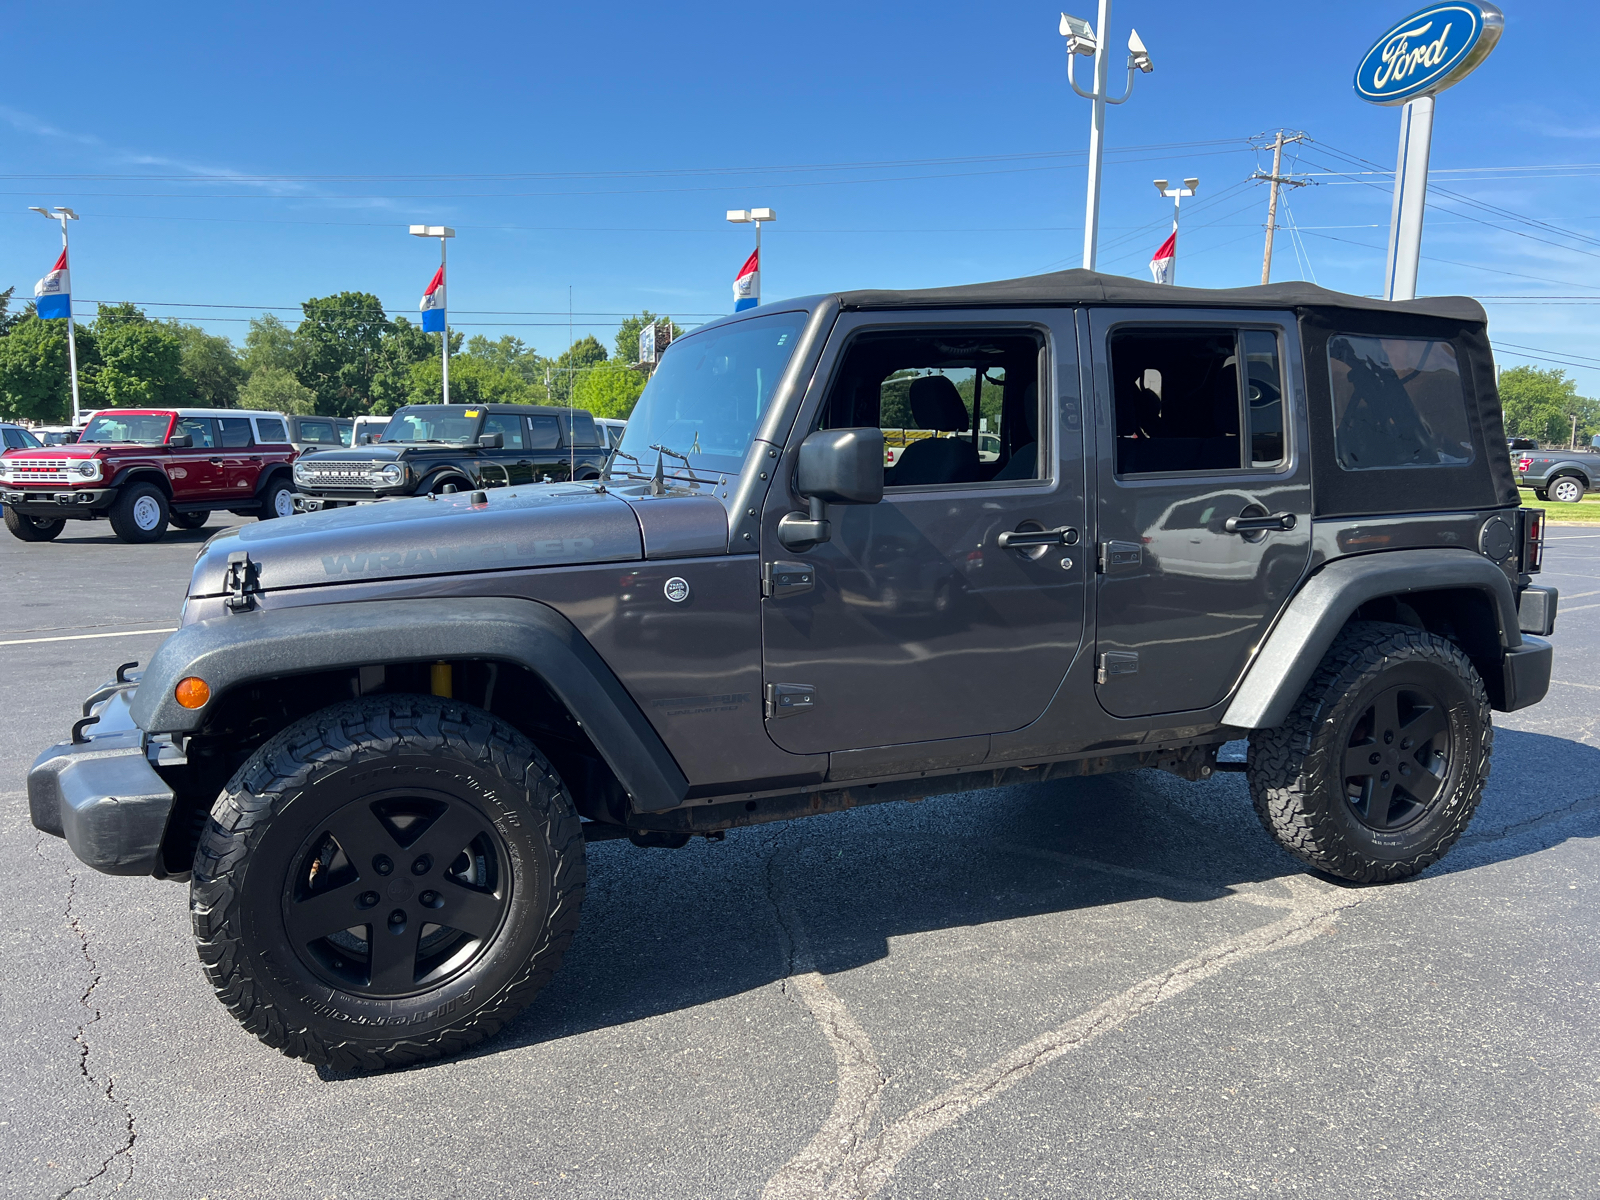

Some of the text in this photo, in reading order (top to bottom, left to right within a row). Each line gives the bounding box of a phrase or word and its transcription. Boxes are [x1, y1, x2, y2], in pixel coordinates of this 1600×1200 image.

[1373, 21, 1453, 89] Ford
[320, 537, 595, 575] WRANGLER
[666, 705, 739, 716] UNLIMITED
